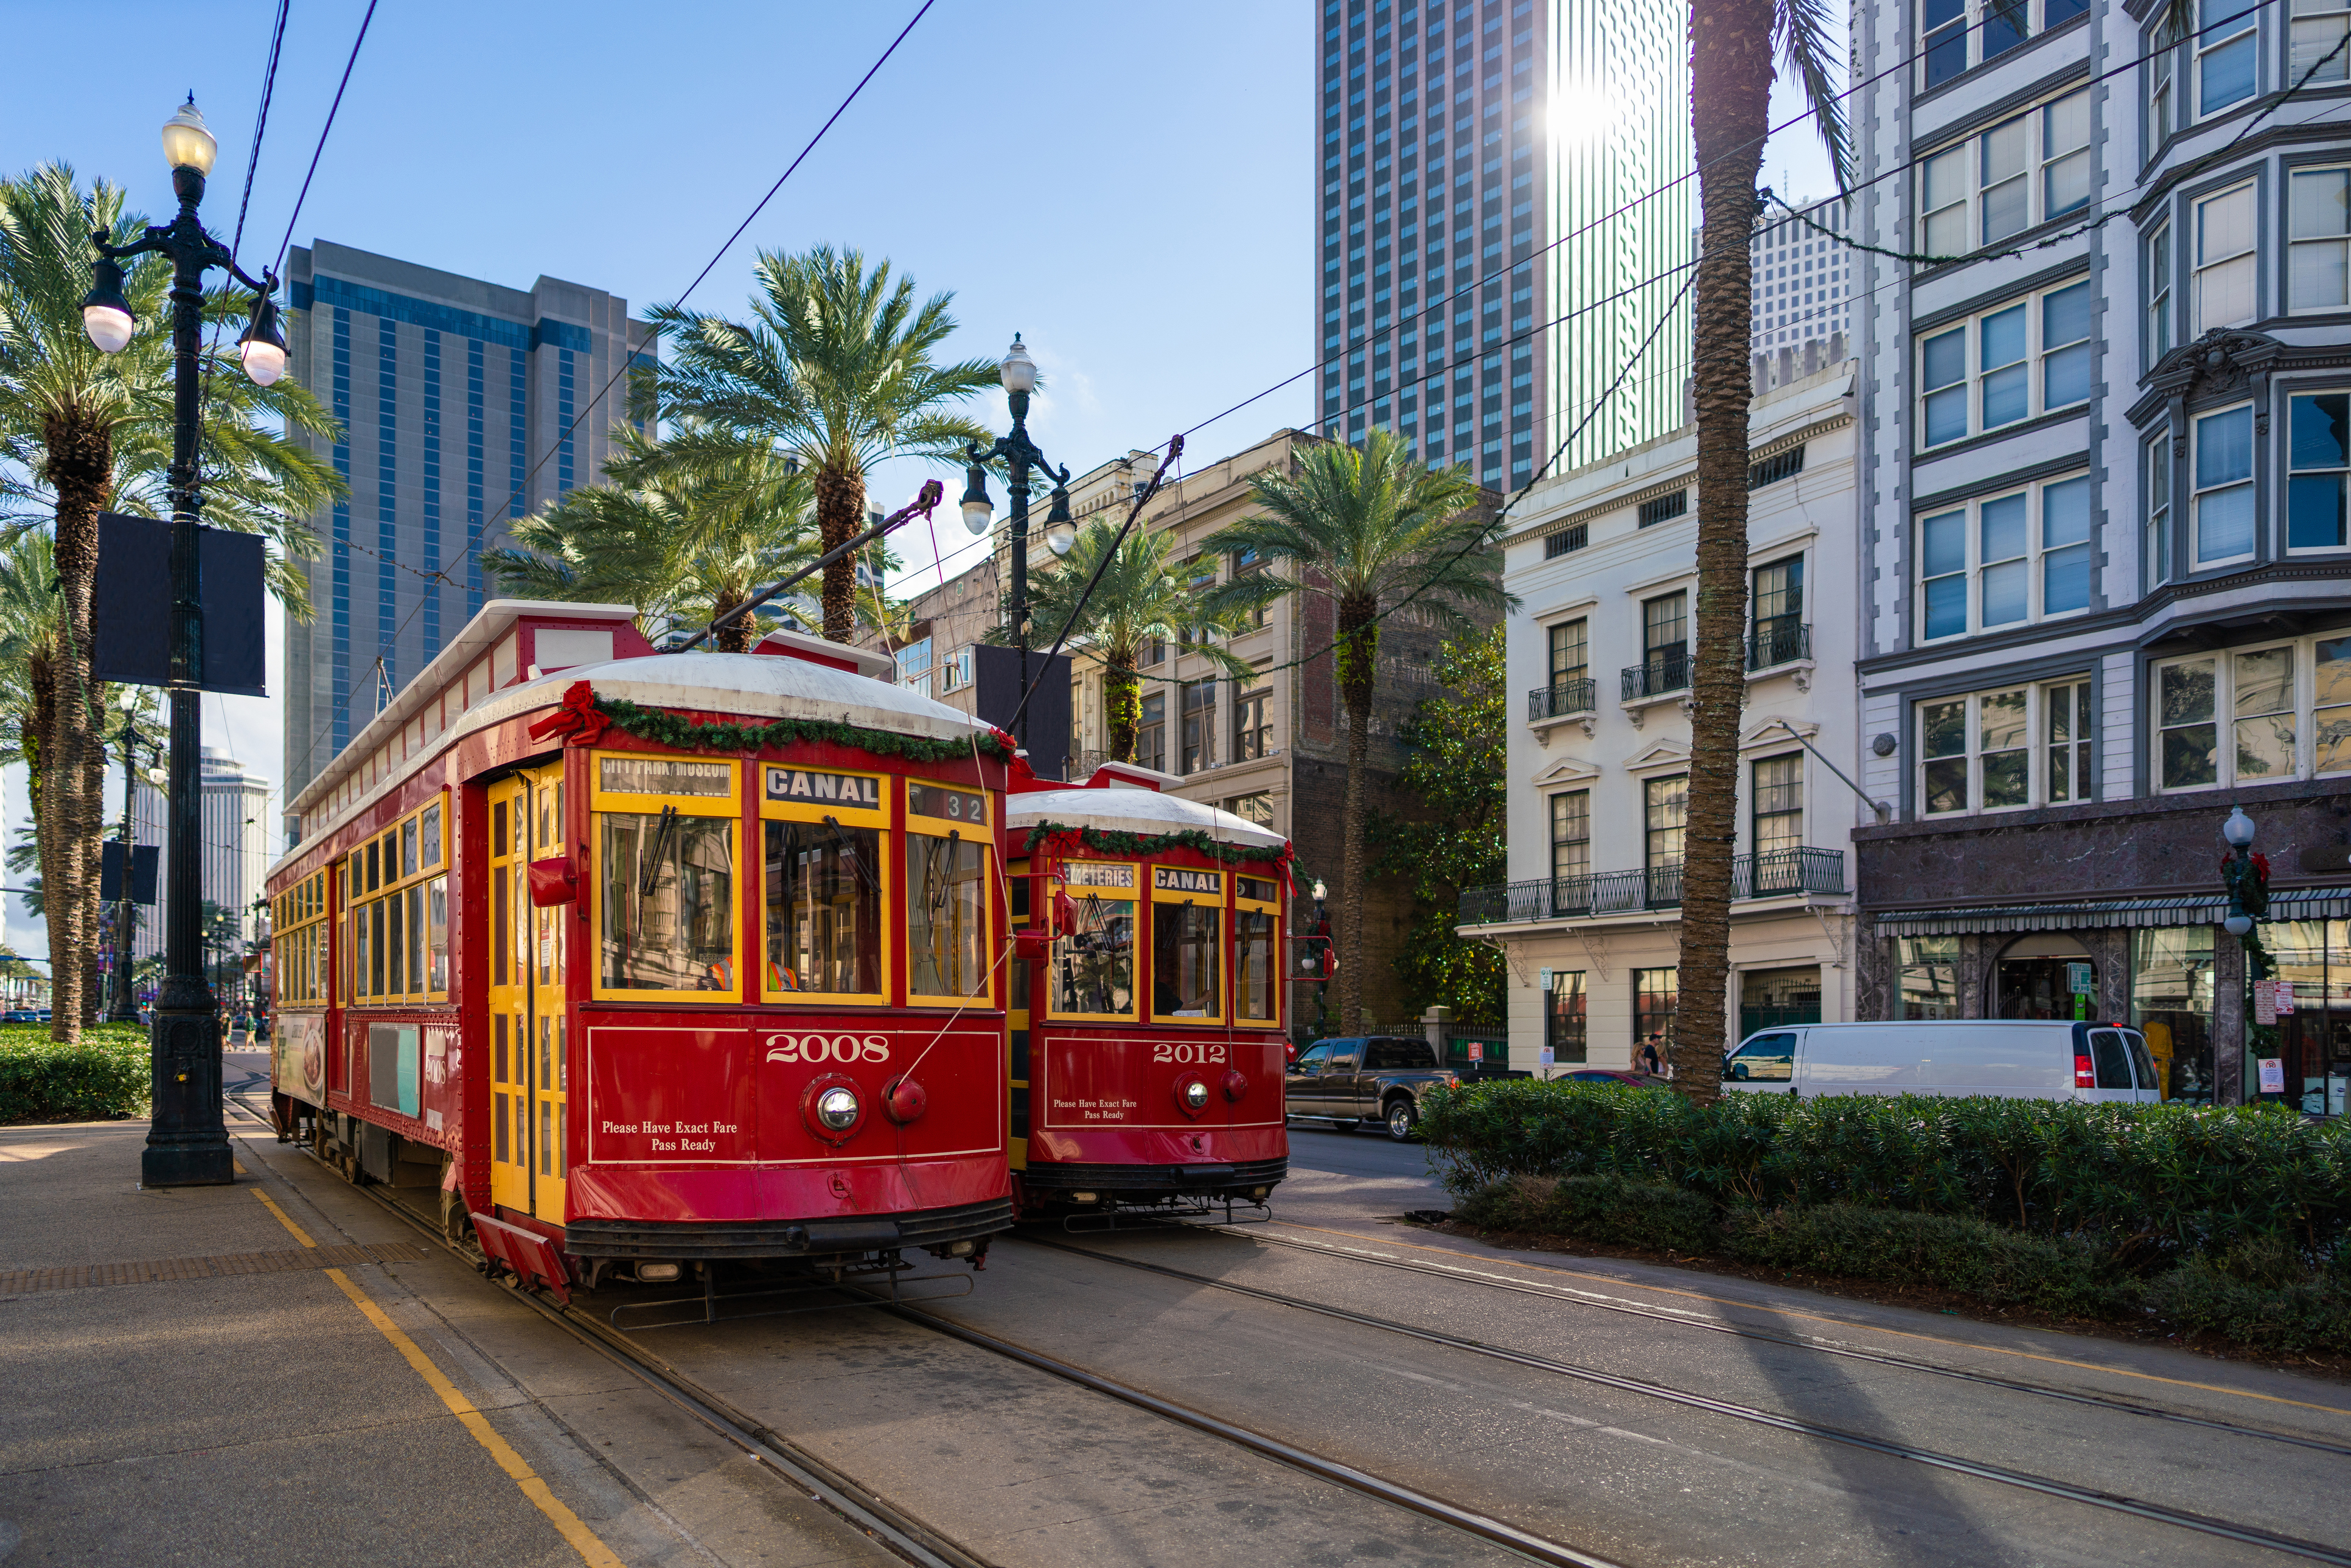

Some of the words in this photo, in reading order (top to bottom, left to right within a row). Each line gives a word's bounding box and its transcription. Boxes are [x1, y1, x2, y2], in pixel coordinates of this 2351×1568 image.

[767, 768, 879, 803] CANAL
[1155, 870, 1219, 891] CANAL
[766, 1035, 890, 1063] 2008
[1154, 1044, 1225, 1064] 2012
[426, 1059, 446, 1084] 2008
[1085, 1110, 1100, 1119] Pass
[1102, 1110, 1124, 1120] Ready
[602, 1121, 638, 1133] Please
[642, 1121, 670, 1133] Have
[675, 1121, 708, 1133] Exact
[713, 1121, 737, 1133] Fare
[652, 1138, 676, 1151] Pass
[681, 1138, 716, 1152] Ready
